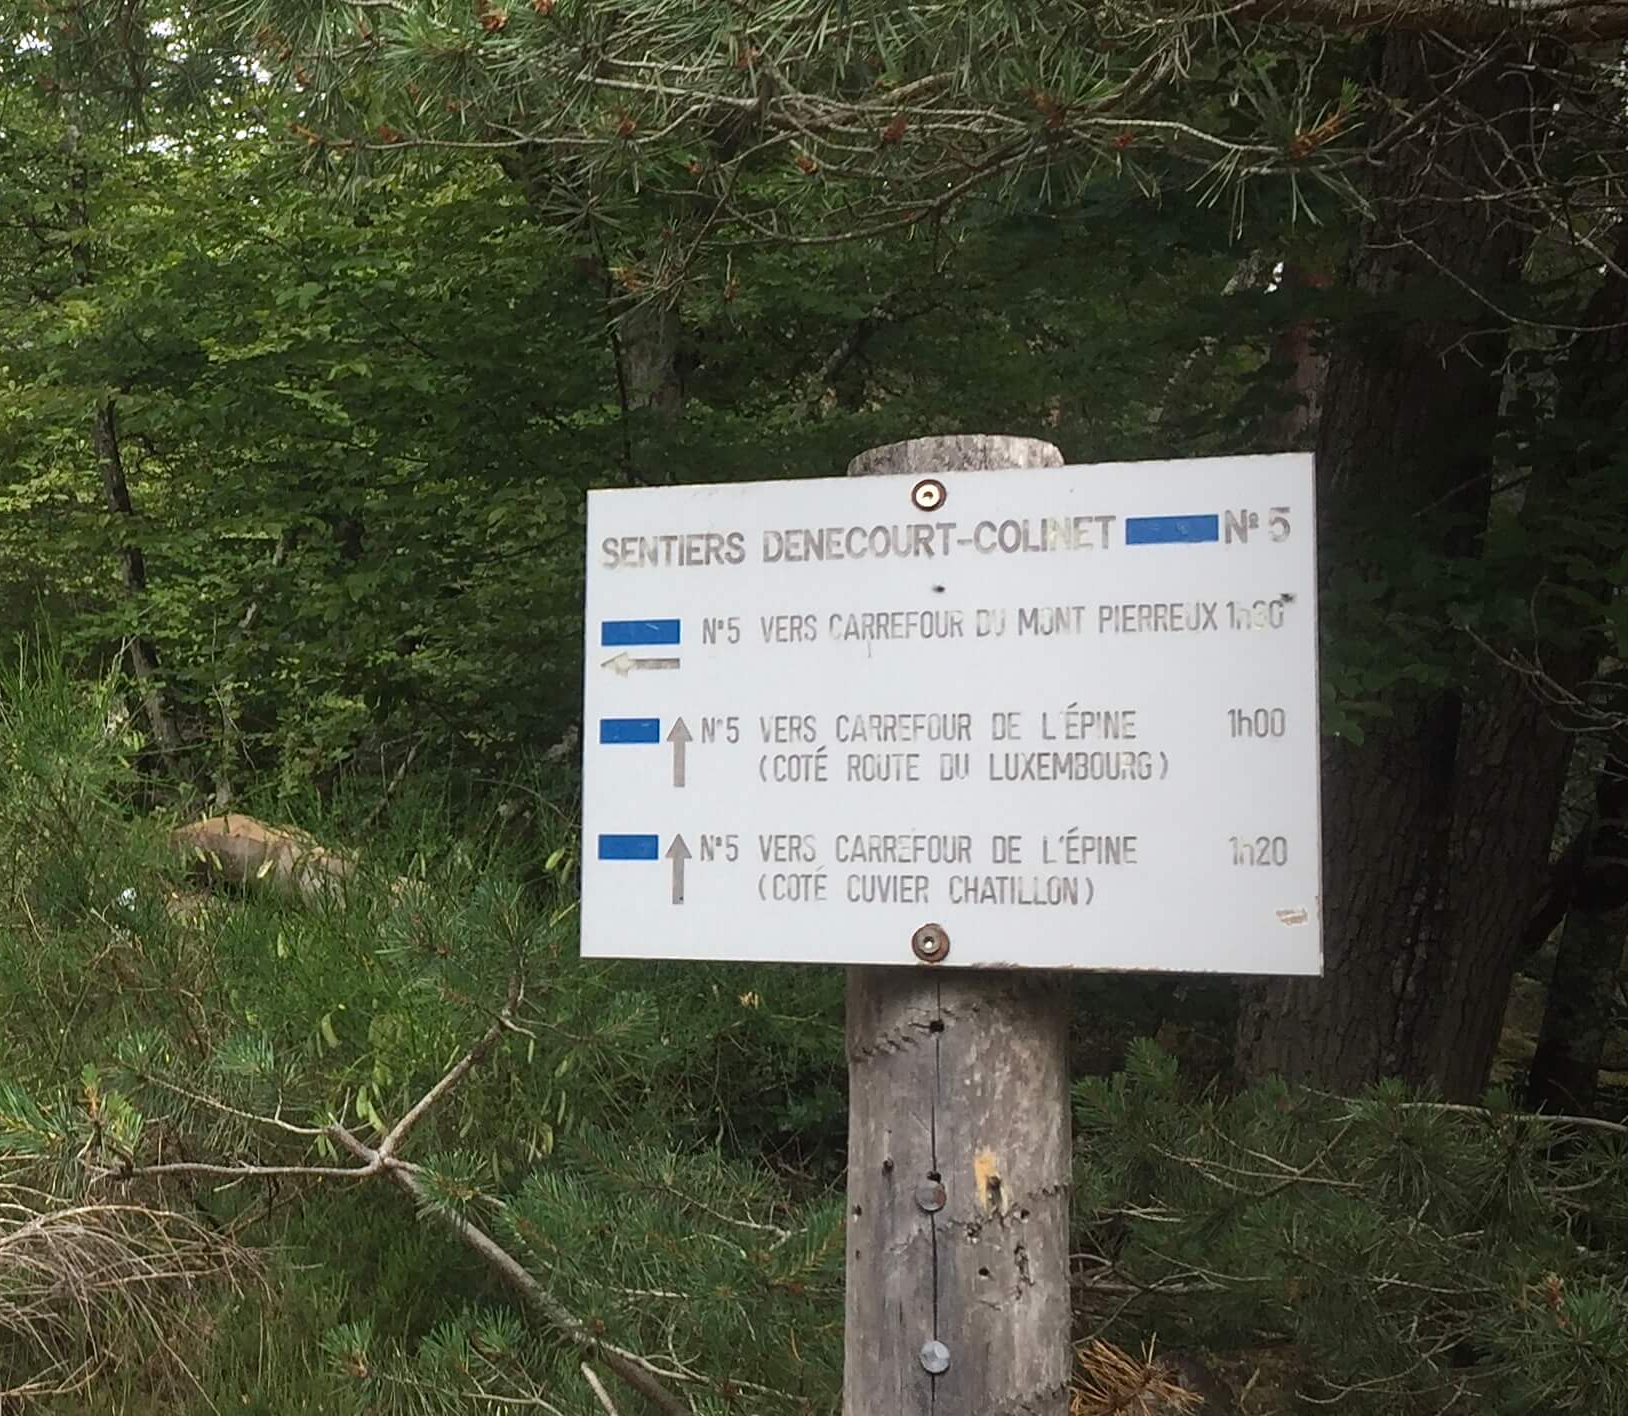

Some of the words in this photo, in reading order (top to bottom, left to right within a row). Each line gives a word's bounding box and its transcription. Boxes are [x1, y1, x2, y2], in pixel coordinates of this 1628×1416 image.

[600, 531, 746, 570] SENTIERS
[762, 514, 1117, 564] DENECOURT-COLINET
[760, 614, 818, 644] VERS
[828, 609, 965, 642] CARREFOUR
[975, 608, 1006, 638] DU
[1017, 605, 1086, 636] MONT
[1098, 602, 1219, 635] PIERREUX
[759, 714, 817, 744] VERS
[835, 713, 972, 743] CARREFOUR
[991, 711, 1022, 741] DE
[1227, 707, 1286, 739] 1h00
[758, 745, 829, 783] (COTÉ
[847, 753, 920, 782] ROUTE
[939, 752, 970, 782] DU
[988, 750, 1169, 782] LUXEMBOURG)
[758, 833, 817, 863] VERS
[835, 834, 972, 864] CARREFOUR
[991, 835, 1022, 865] DE
[1042, 826, 1138, 865] L'ÉPINE
[1228, 835, 1289, 867] 1h20
[758, 865, 829, 902] (COTÉ
[846, 873, 930, 904] CUVIER
[948, 875, 1095, 906] CHATILLON)
